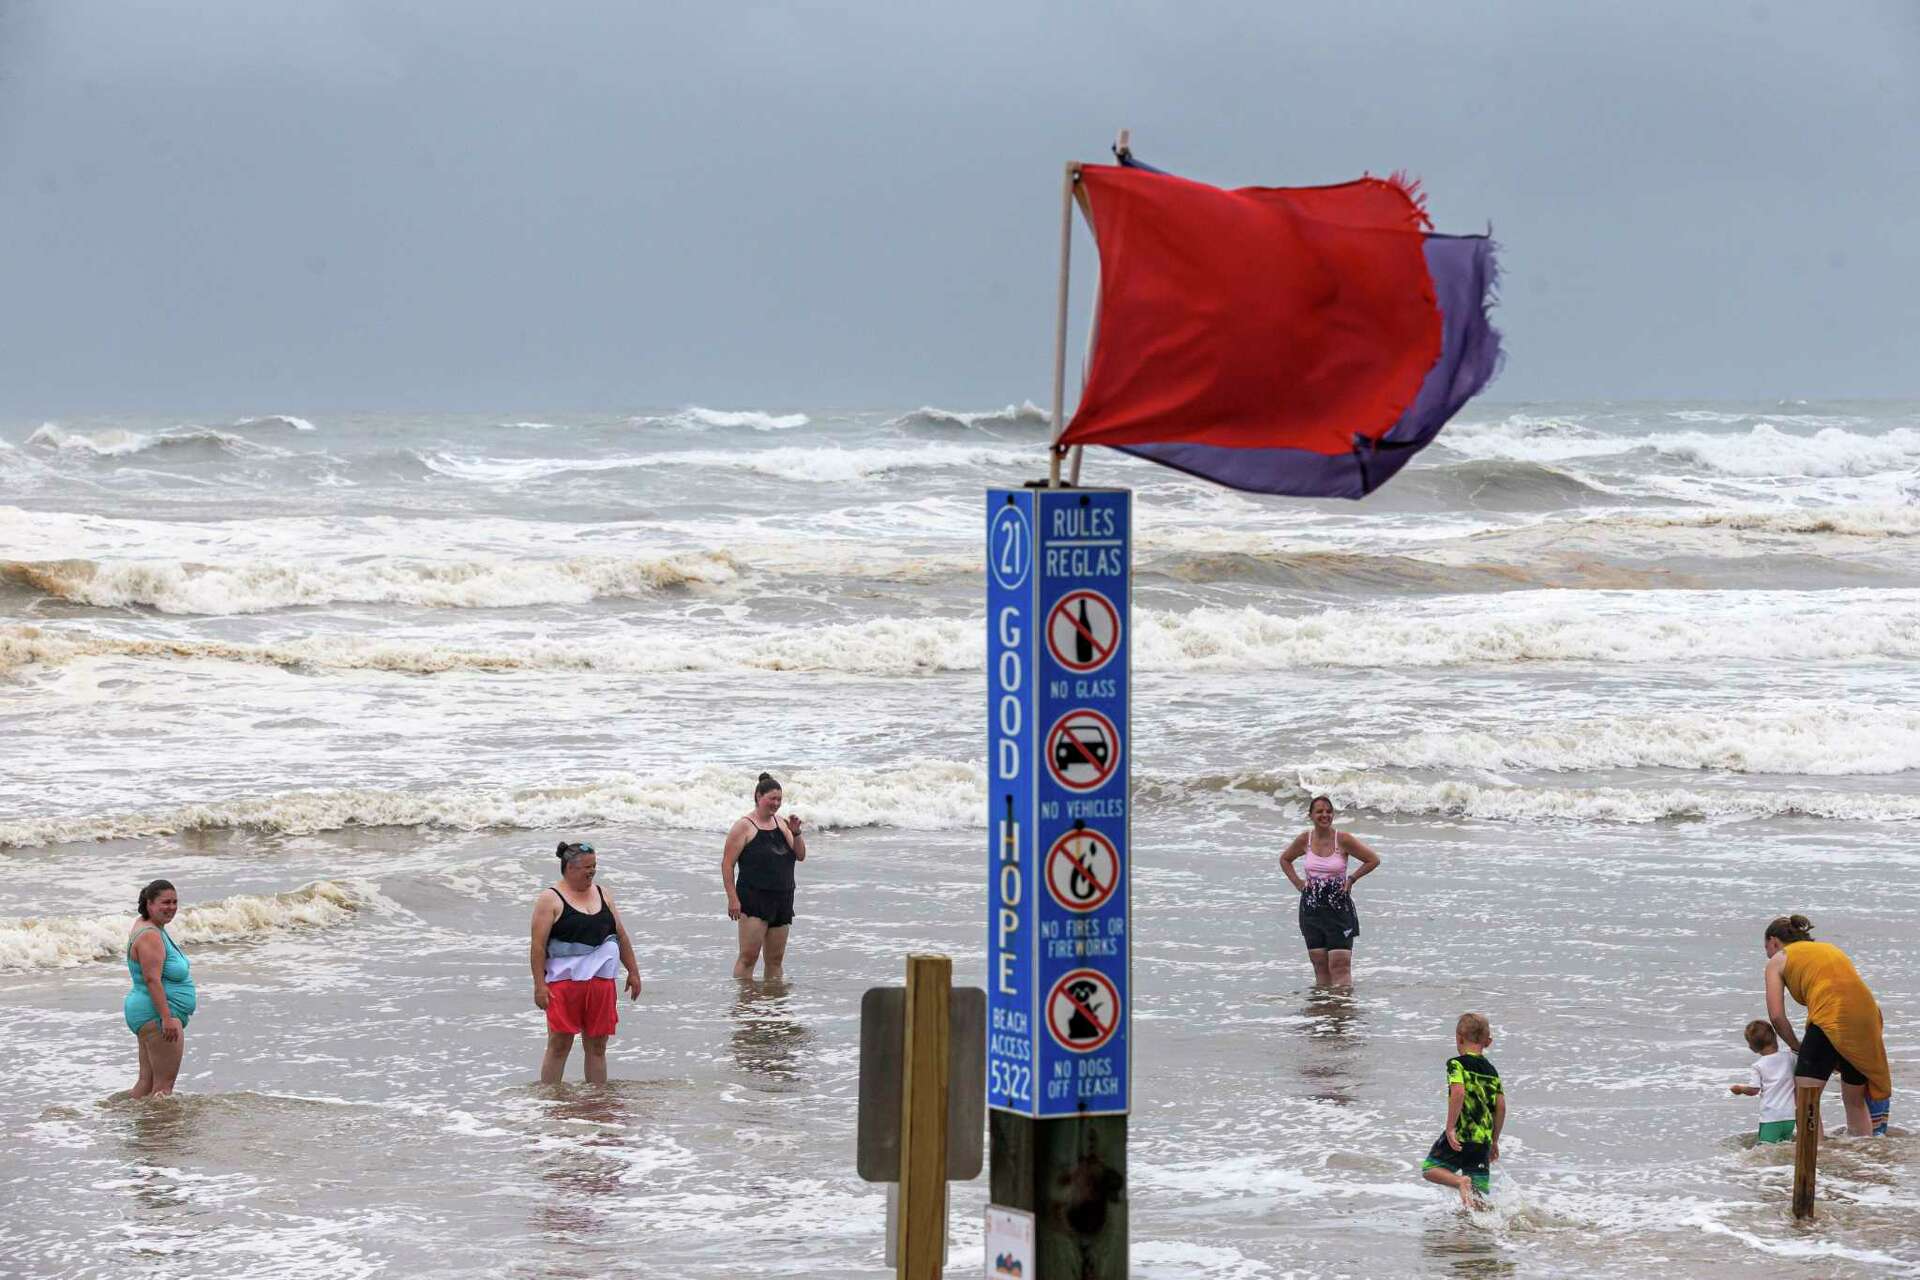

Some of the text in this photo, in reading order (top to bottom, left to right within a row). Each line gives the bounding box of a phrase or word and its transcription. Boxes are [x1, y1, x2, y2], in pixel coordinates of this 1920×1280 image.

[1053, 508, 1115, 537] RULES
[1001, 520, 1020, 575] 21
[1046, 548, 1121, 577] REGLAS
[1000, 606, 1022, 780] GOOD
[1051, 679, 1116, 699] NO GLASS
[1041, 799, 1123, 819] NO VEHICLES
[999, 819, 1022, 996] HOPE
[1041, 918, 1124, 938] NO FIRES OR
[1048, 938, 1117, 958] FIREWORKS
[993, 1007, 1027, 1035] BEACH
[991, 1033, 1030, 1061] ACCESS
[991, 1060, 1031, 1101] 5322
[1054, 1058, 1112, 1079] NO DOGS
[1048, 1077, 1118, 1099] OFF LEASH
